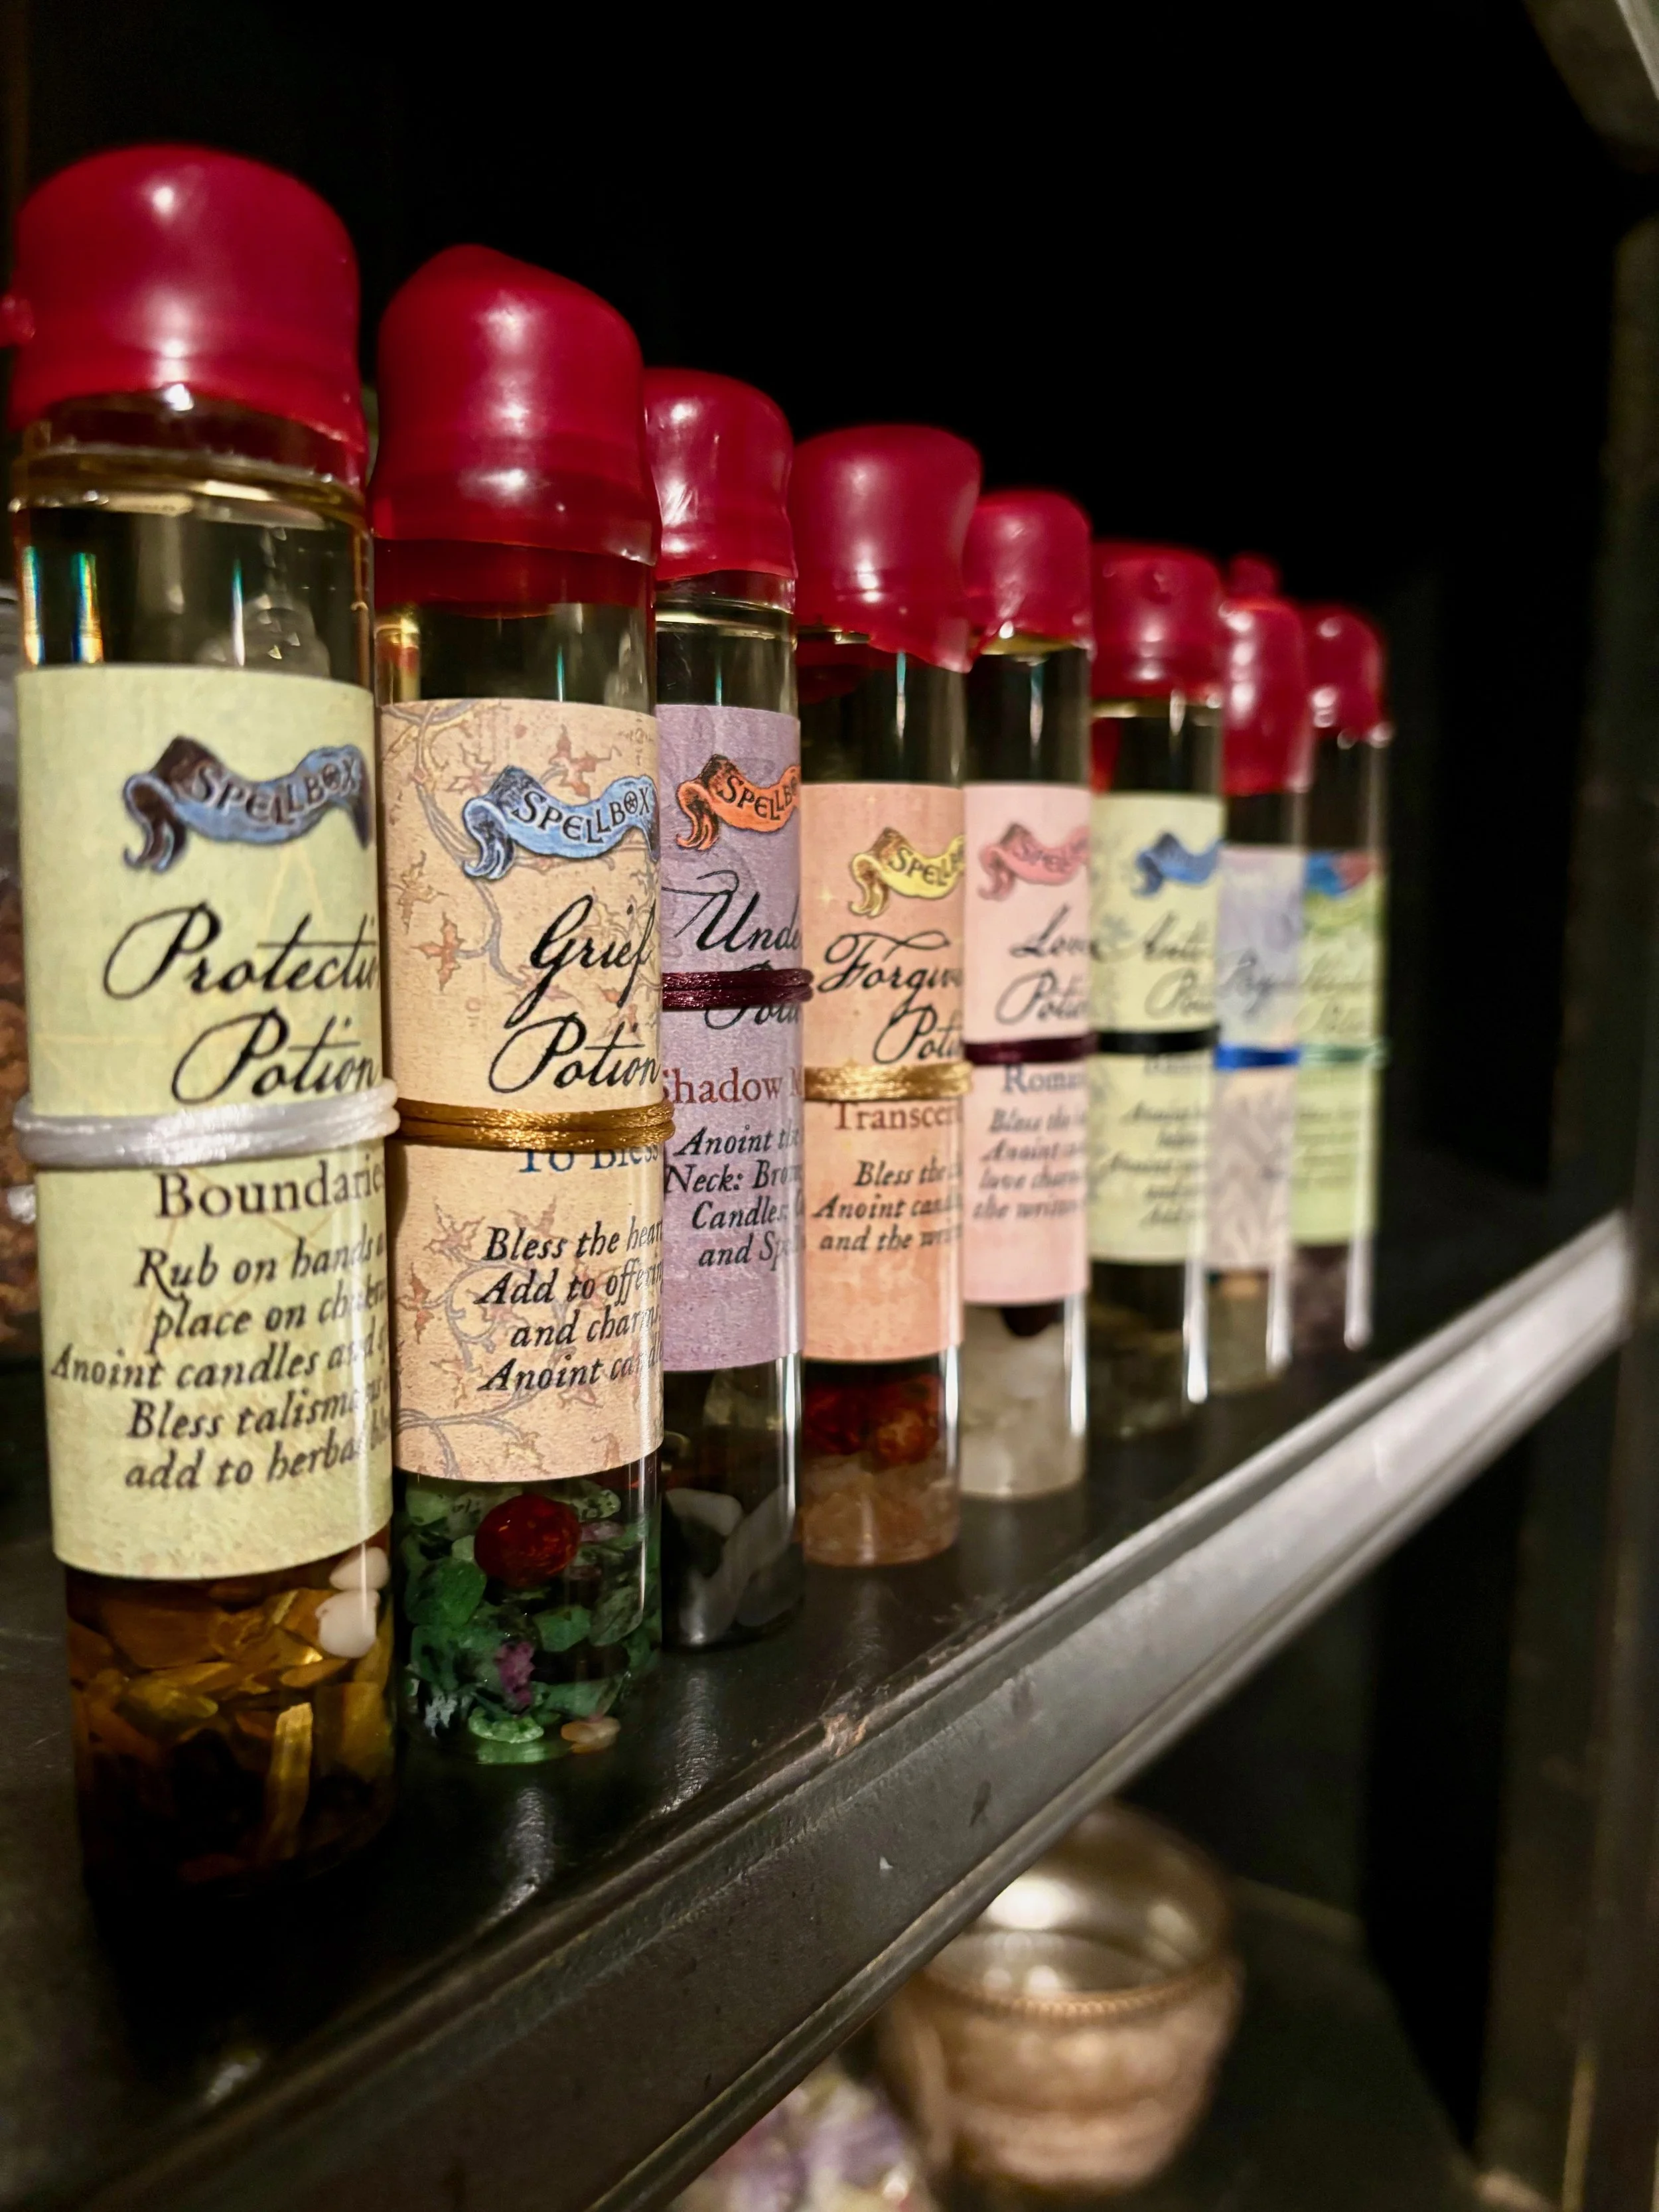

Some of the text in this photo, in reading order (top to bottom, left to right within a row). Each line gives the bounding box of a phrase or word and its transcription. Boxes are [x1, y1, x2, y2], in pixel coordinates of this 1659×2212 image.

[188, 759, 360, 825] SPELLBOX
[512, 784, 653, 844] SPELLBOX
[504, 895, 656, 1029] Grief
[171, 1007, 380, 1104] Potion
[489, 1012, 660, 1094] Potion
[673, 1124, 775, 1156] Anoint
[155, 1153, 384, 1220] Boundarie
[664, 1162, 743, 1193] Neck:
[854, 1159, 914, 1187] Bless
[812, 1193, 906, 1219] Anoint
[482, 1226, 568, 1261] Bless
[577, 1220, 620, 1257] the
[698, 1232, 753, 1268] and
[820, 1224, 871, 1251] and
[877, 1223, 912, 1252] the
[133, 1243, 219, 1300] Rub
[233, 1258, 277, 1286] on
[291, 1222, 374, 1281] hands
[475, 1268, 560, 1305] Add
[567, 1276, 595, 1301] to
[149, 1296, 252, 1355] place
[265, 1300, 307, 1330] on
[510, 1309, 579, 1347] and
[50, 1343, 164, 1390] Anoint
[177, 1339, 321, 1390] candles
[478, 1355, 604, 1391] Anoint
[126, 1397, 225, 1441] Bless
[125, 1447, 206, 1491] add
[216, 1459, 253, 1487] to
